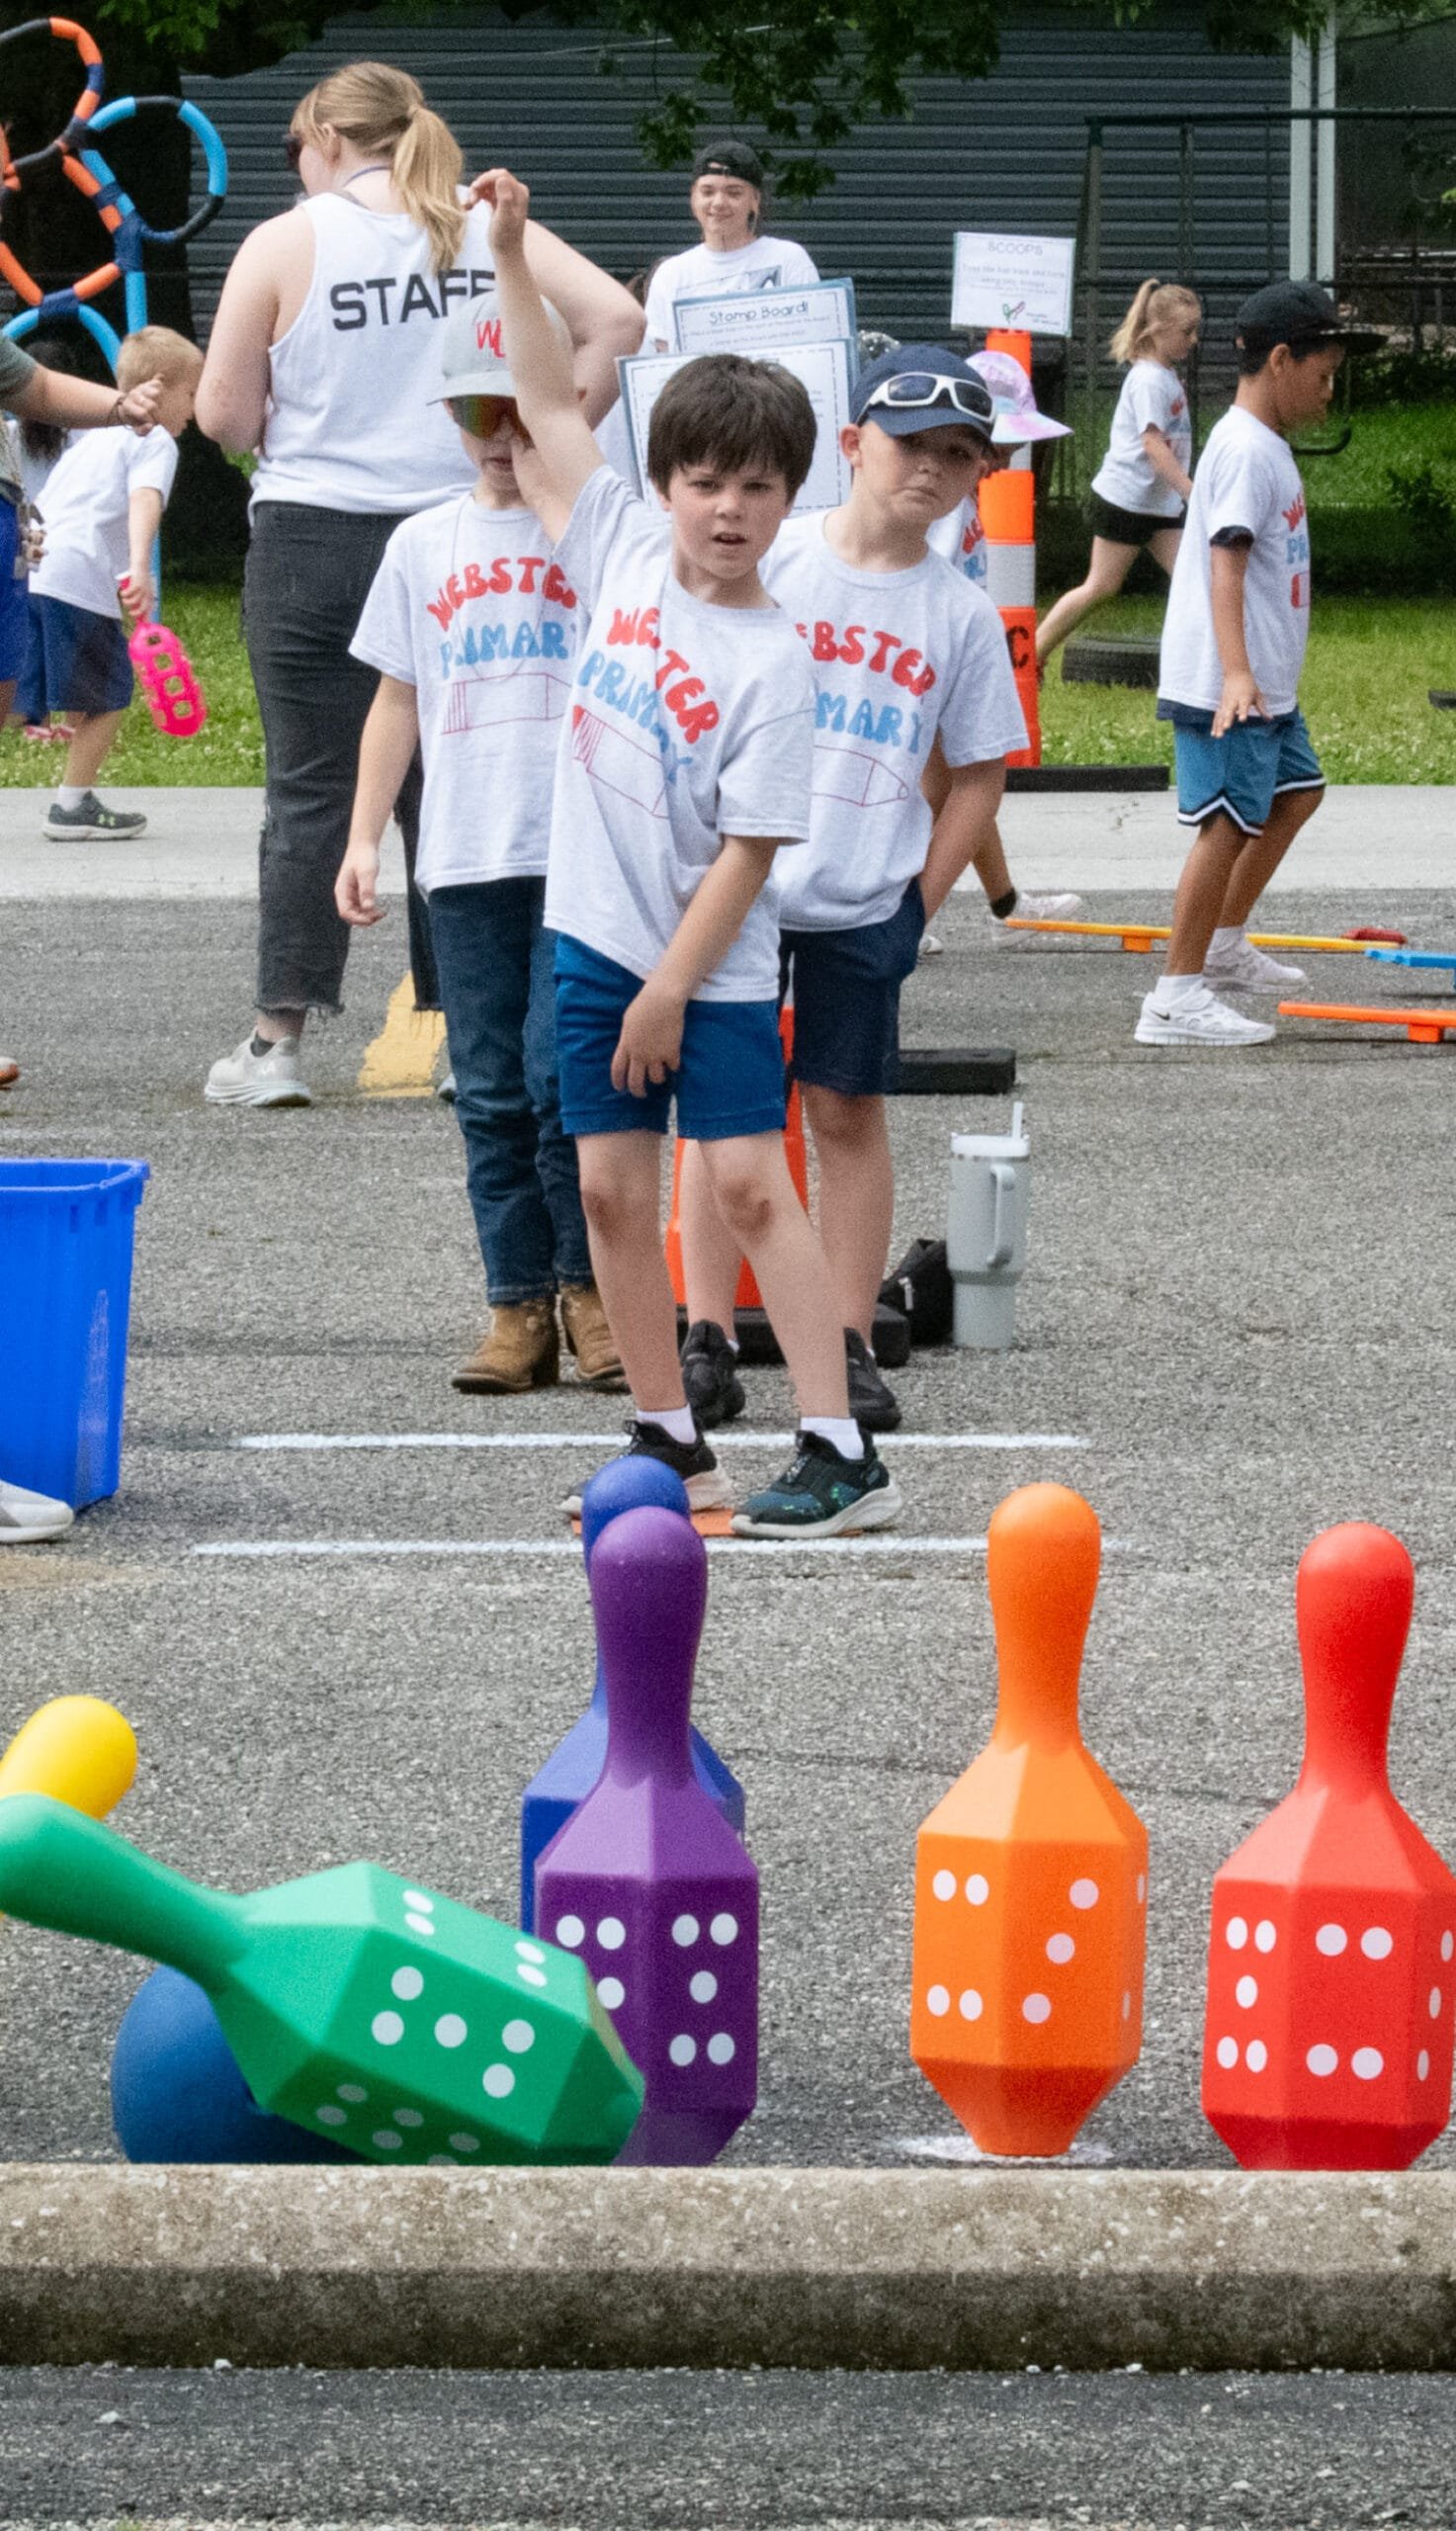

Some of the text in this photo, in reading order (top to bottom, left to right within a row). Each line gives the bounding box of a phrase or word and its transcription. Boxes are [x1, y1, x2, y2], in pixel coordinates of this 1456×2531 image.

[988, 241, 1043, 256] SCOOPS
[710, 309, 757, 325] Stomp
[440, 621, 576, 680] PIMAR
[607, 607, 720, 744] WETER
